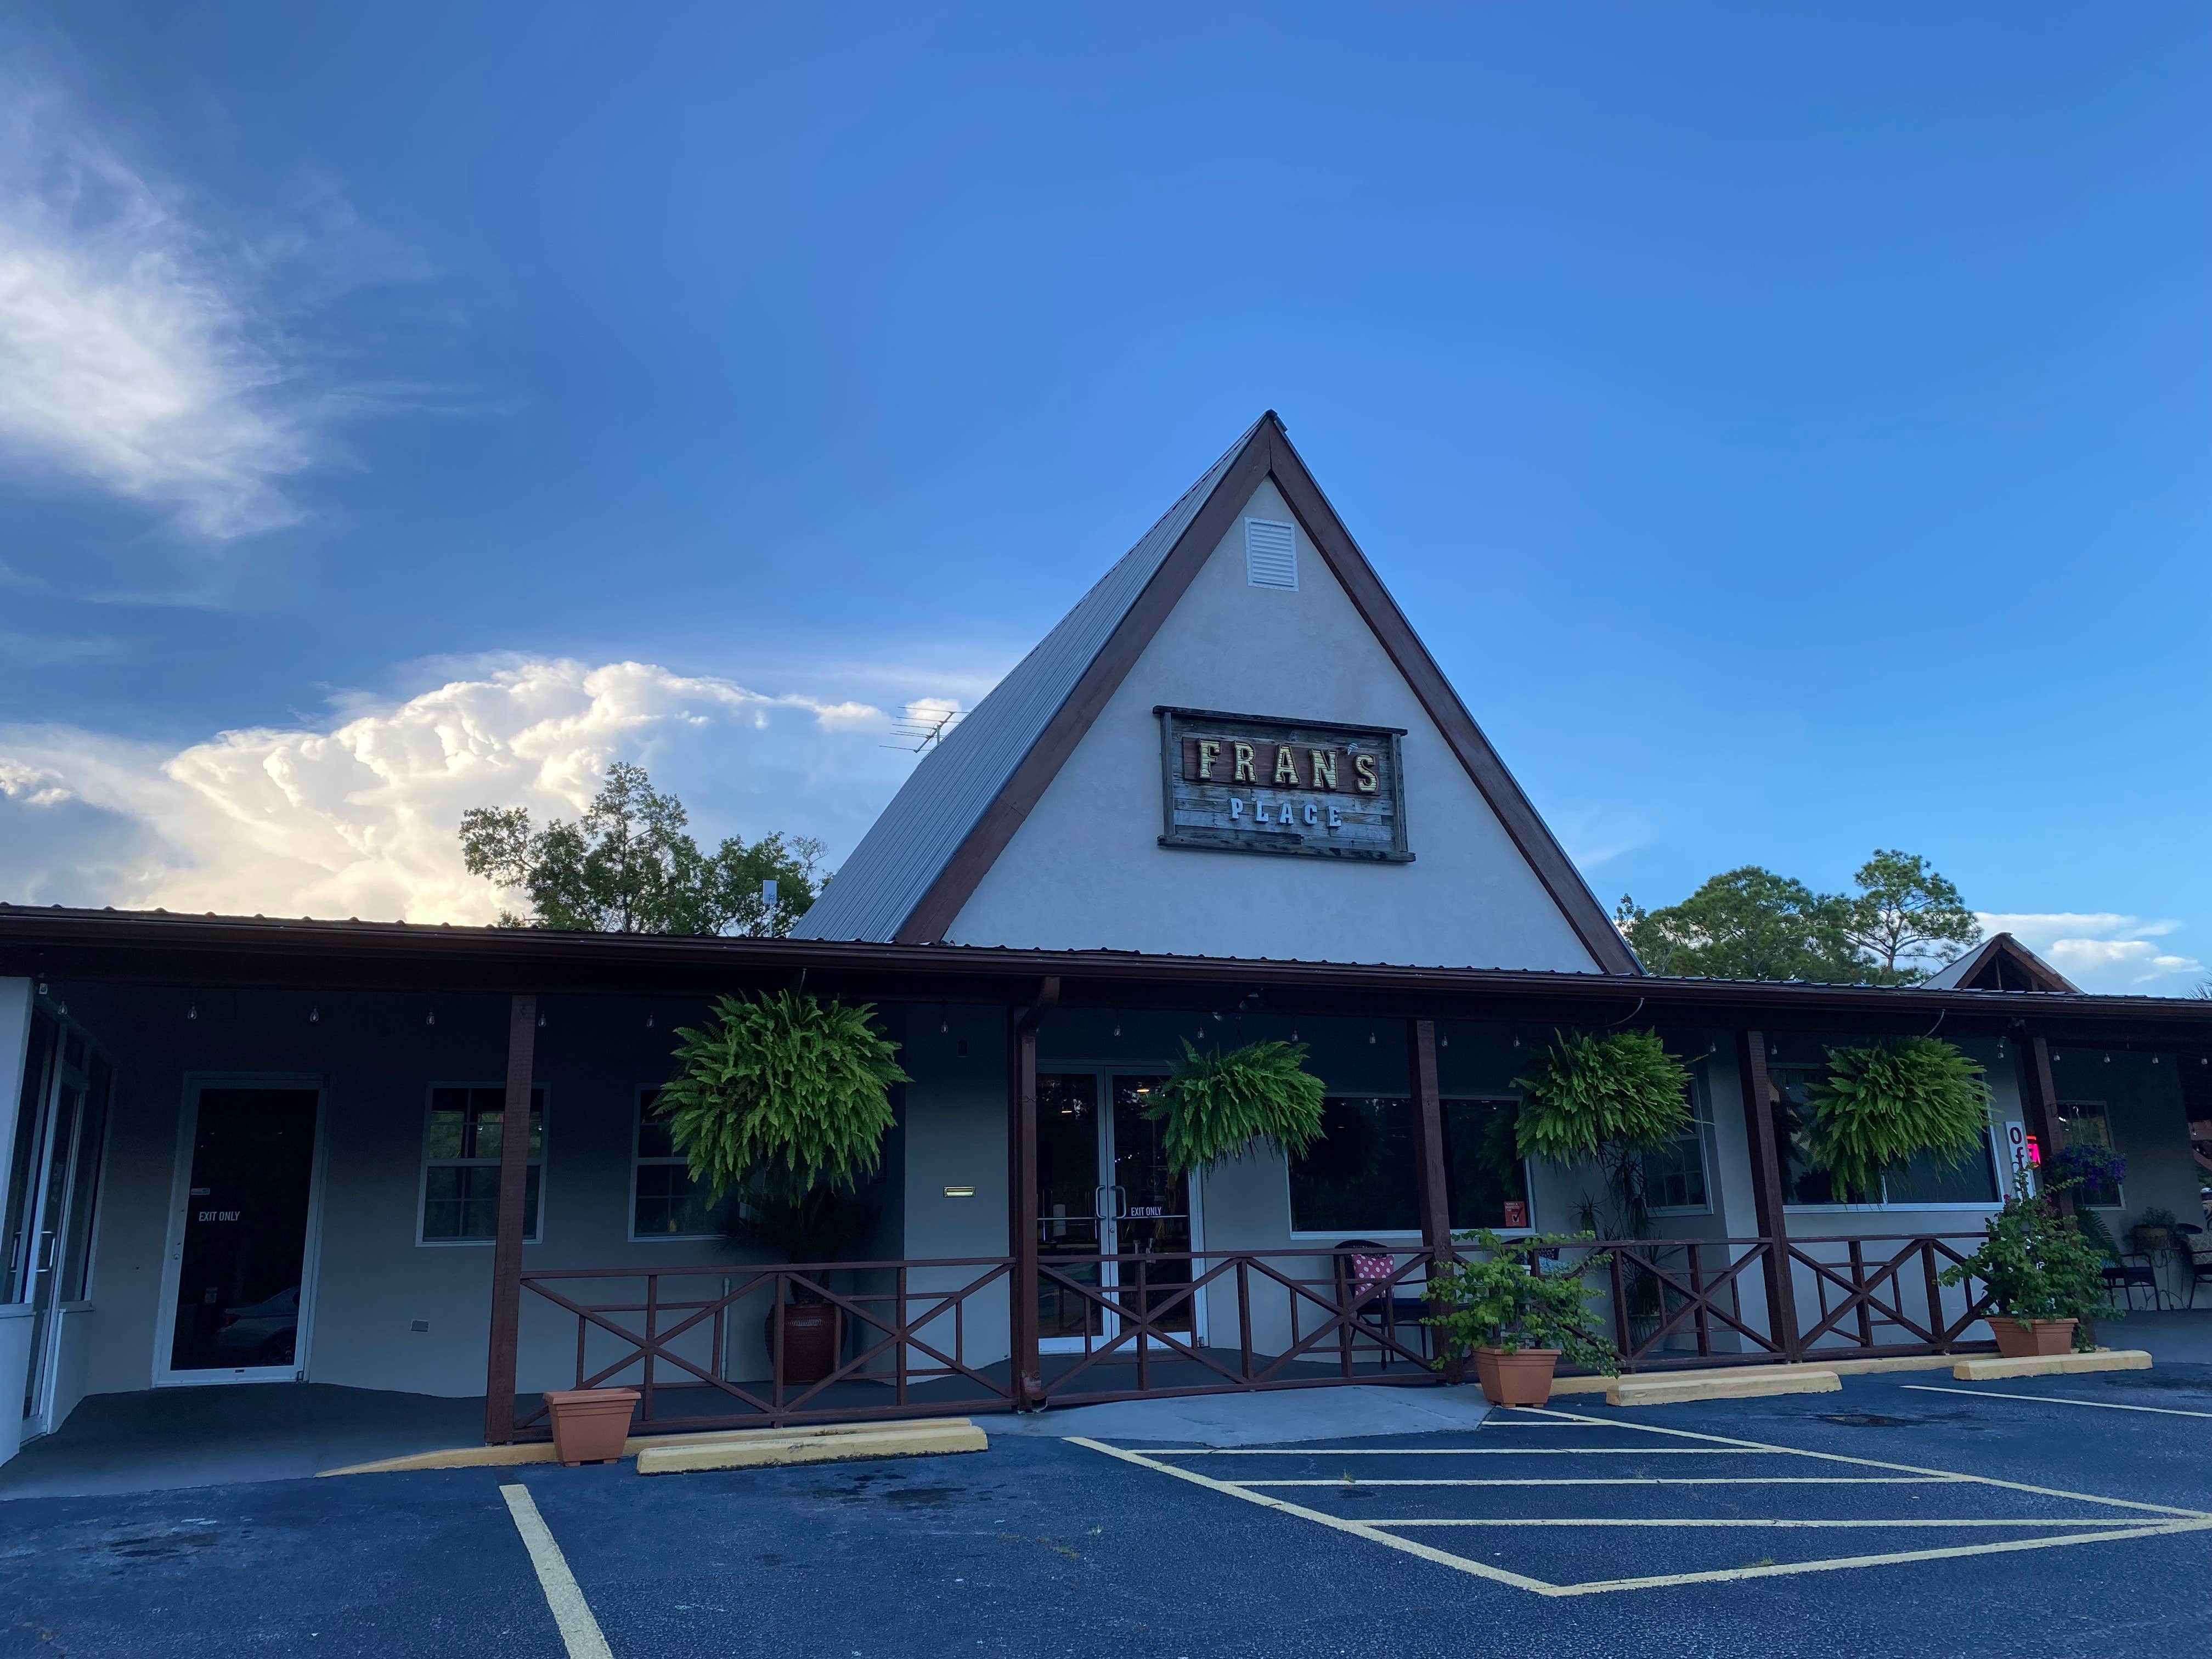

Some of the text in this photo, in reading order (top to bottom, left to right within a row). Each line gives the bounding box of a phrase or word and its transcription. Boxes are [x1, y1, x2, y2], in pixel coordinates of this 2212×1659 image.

[1197, 737, 1378, 793] FRAN'S
[1229, 797, 1342, 827] PLACE
[199, 1211, 240, 1221] EXIT ONLY
[1131, 1206, 1162, 1216] EXIT ONLY
